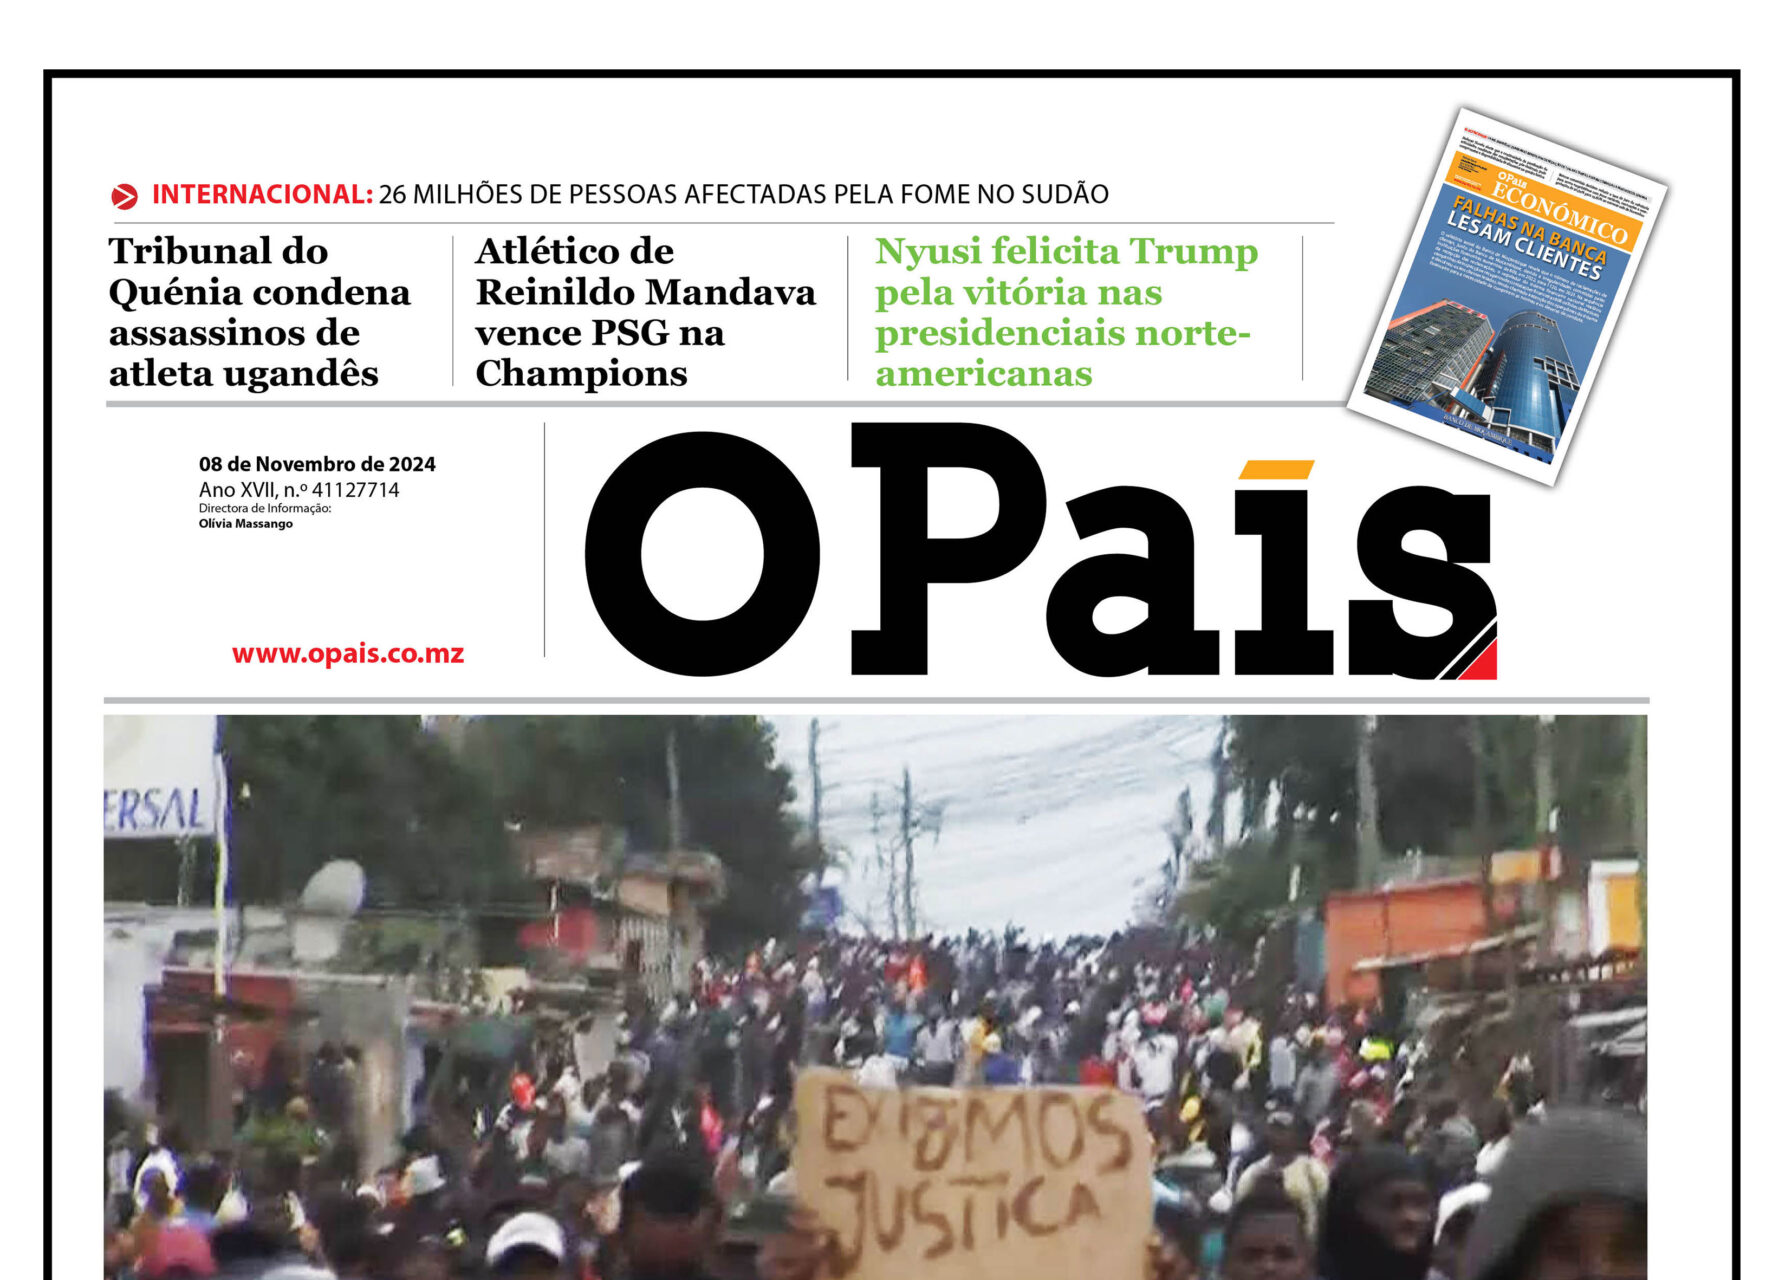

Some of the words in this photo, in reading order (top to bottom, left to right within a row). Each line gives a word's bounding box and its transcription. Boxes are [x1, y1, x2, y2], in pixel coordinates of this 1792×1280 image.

[154, 184, 372, 204] INTERNACIONAL:
[379, 185, 406, 204] 26
[414, 180, 522, 204] MILHÕES
[531, 184, 561, 204] DE
[571, 184, 676, 204] PESSOAS
[685, 184, 826, 204] AFECTADAS
[835, 184, 893, 204] PELA
[902, 184, 970, 204] FOME
[979, 184, 1014, 204] NO
[1023, 180, 1109, 204] SUDÃO
[1491, 181, 1628, 244] ECONÓMICO
[1453, 195, 1519, 229] FALHAS
[1520, 221, 1544, 241] NA
[1549, 232, 1606, 264] BANCA
[108, 235, 272, 264] Tribunal
[282, 235, 328, 264] do
[474, 235, 619, 264] Atlético
[630, 235, 674, 264] de
[875, 235, 982, 271] Nyusi
[992, 235, 1120, 264] felicita
[1130, 238, 1258, 271] Trump
[1447, 210, 1511, 246] LESAM
[1515, 237, 1602, 280] CLIENTES
[110, 276, 243, 312] Quénia
[253, 276, 411, 305] condena
[476, 276, 635, 305] Reinildo
[645, 276, 817, 305] Mandava
[875, 276, 954, 312] pela
[963, 276, 1088, 305] vitória
[1098, 286, 1162, 305] nas
[110, 317, 305, 346] assassinos
[316, 317, 359, 346] de
[475, 327, 581, 346] vence
[592, 319, 670, 346] PSG
[679, 327, 725, 346] na
[875, 317, 1125, 353] presidenciais
[1136, 322, 1250, 346] norte-
[110, 357, 214, 386] atleta
[223, 358, 378, 393] ugandês
[476, 357, 687, 393] Champions
[877, 358, 1092, 386] americanas
[199, 457, 222, 471] 08
[228, 456, 251, 471] de
[257, 456, 355, 472] Novembro
[361, 456, 384, 472] de
[389, 457, 436, 472] 2024
[199, 482, 235, 497] Ano
[241, 482, 278, 500] XVII,
[312, 482, 400, 498] 41127714
[200, 503, 248, 513] Directora
[251, 503, 265, 513] de
[268, 503, 331, 515] Informação:
[199, 518, 232, 528] Olívia
[236, 519, 293, 531] Massango
[232, 641, 464, 669] www.opais.co.mz
